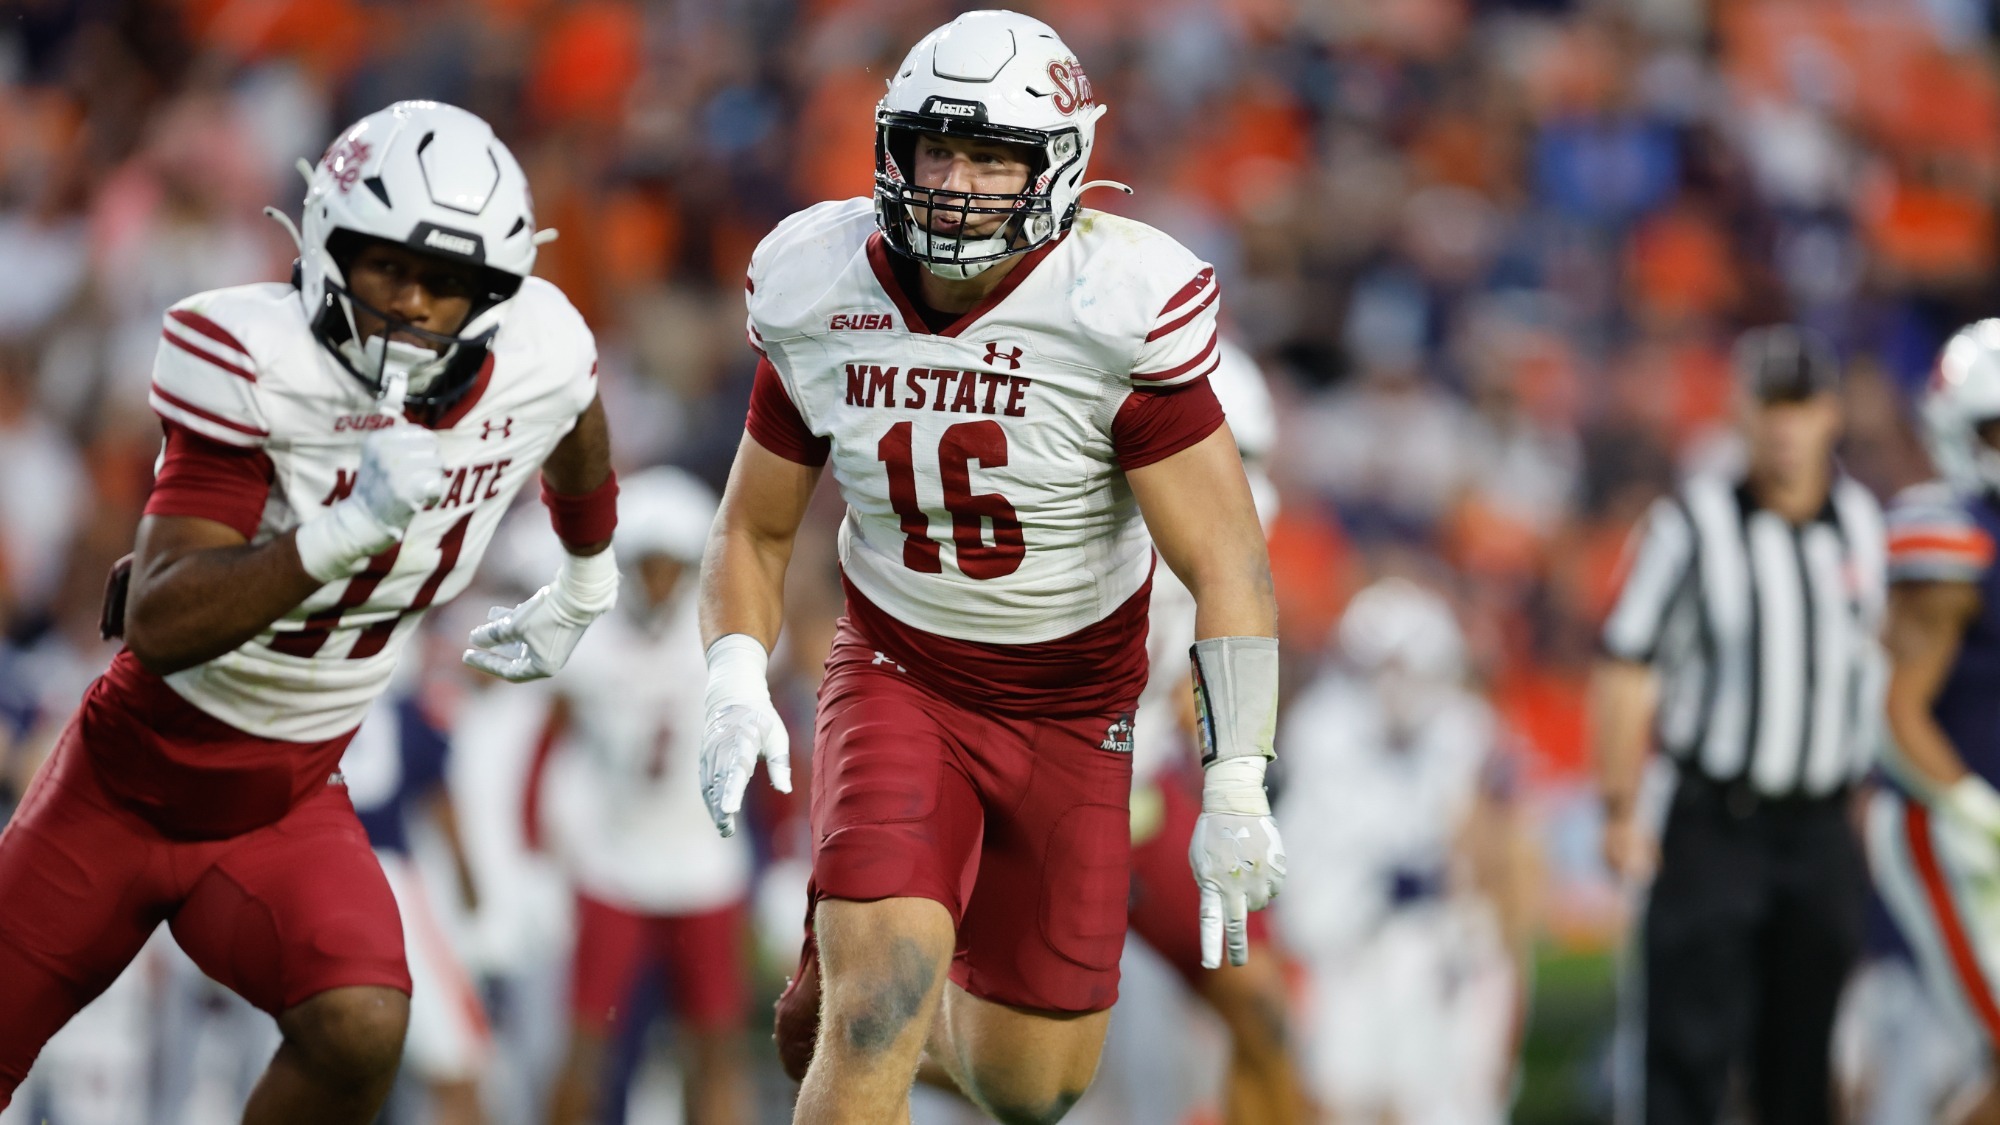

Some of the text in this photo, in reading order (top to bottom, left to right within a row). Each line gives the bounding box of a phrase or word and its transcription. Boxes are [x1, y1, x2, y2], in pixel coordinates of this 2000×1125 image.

[845, 364, 1032, 418] NM STATE
[877, 419, 1027, 580] 16
